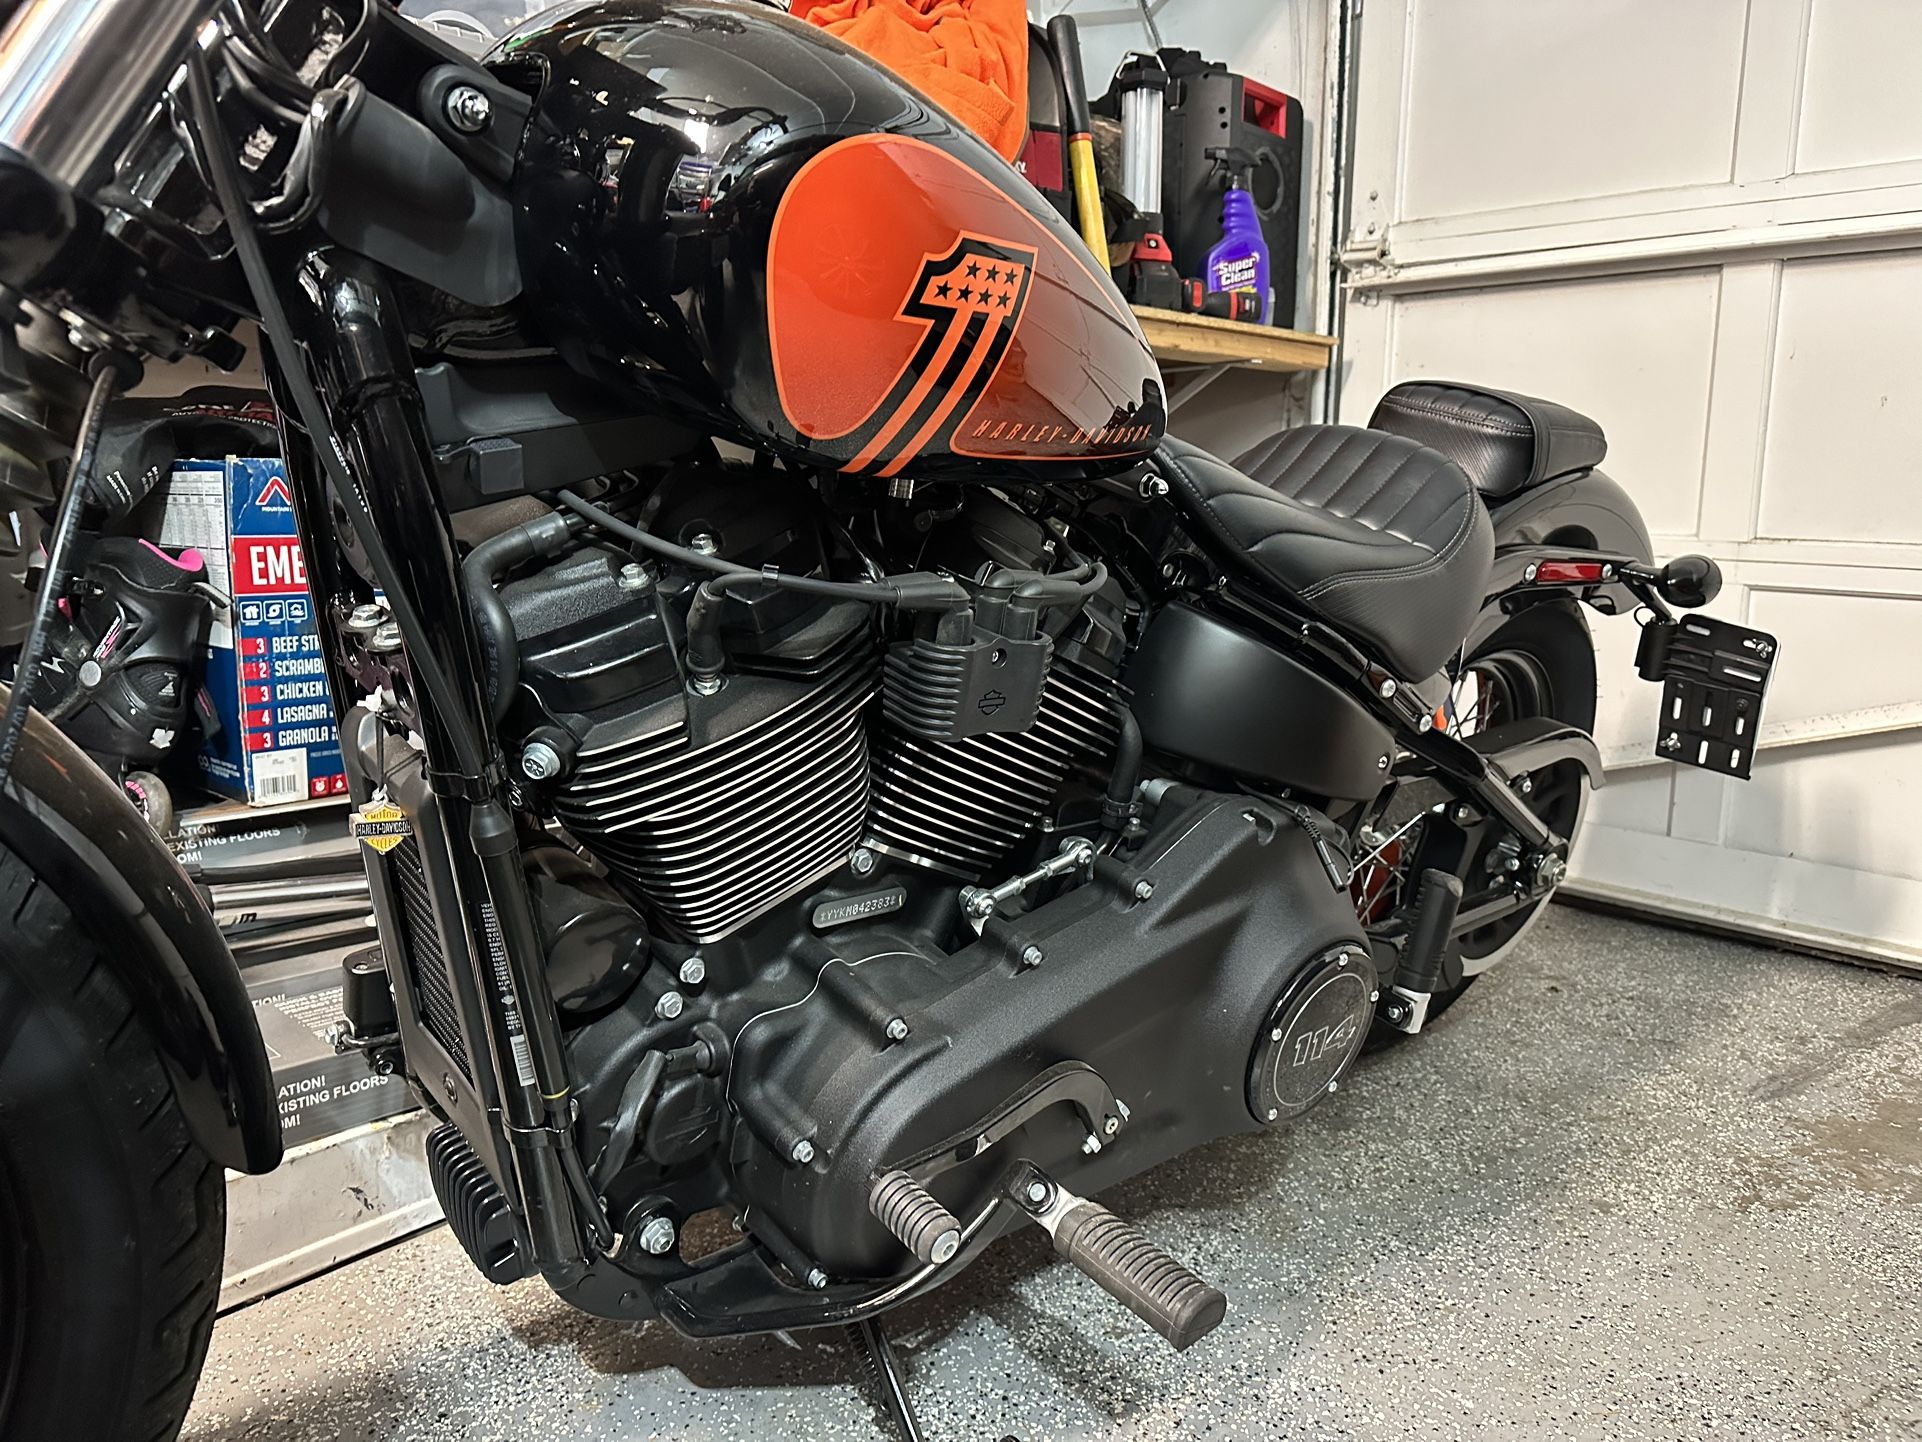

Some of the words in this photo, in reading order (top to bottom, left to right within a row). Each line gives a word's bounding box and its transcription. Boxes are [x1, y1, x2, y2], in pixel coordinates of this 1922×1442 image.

[1217, 257, 1256, 276] Super
[1221, 268, 1256, 286] Clean
[250, 545, 307, 585] EME
[256, 638, 264, 654] 3
[272, 636, 299, 653] BEEF
[259, 663, 267, 678] 2
[260, 686, 269, 702] 3
[276, 681, 323, 700] CHICKEN
[261, 710, 270, 725] 4
[277, 703, 327, 724] LASAGNA
[263, 733, 271, 748] 3
[278, 726, 328, 747] GRANOLA
[356, 821, 411, 836] HARLEY-DAVIDSON
[168, 836, 227, 852] EXISTING
[1293, 1014, 1356, 1067] 114
[278, 1074, 326, 1099] ATION!
[333, 1075, 389, 1098] FLOORS
